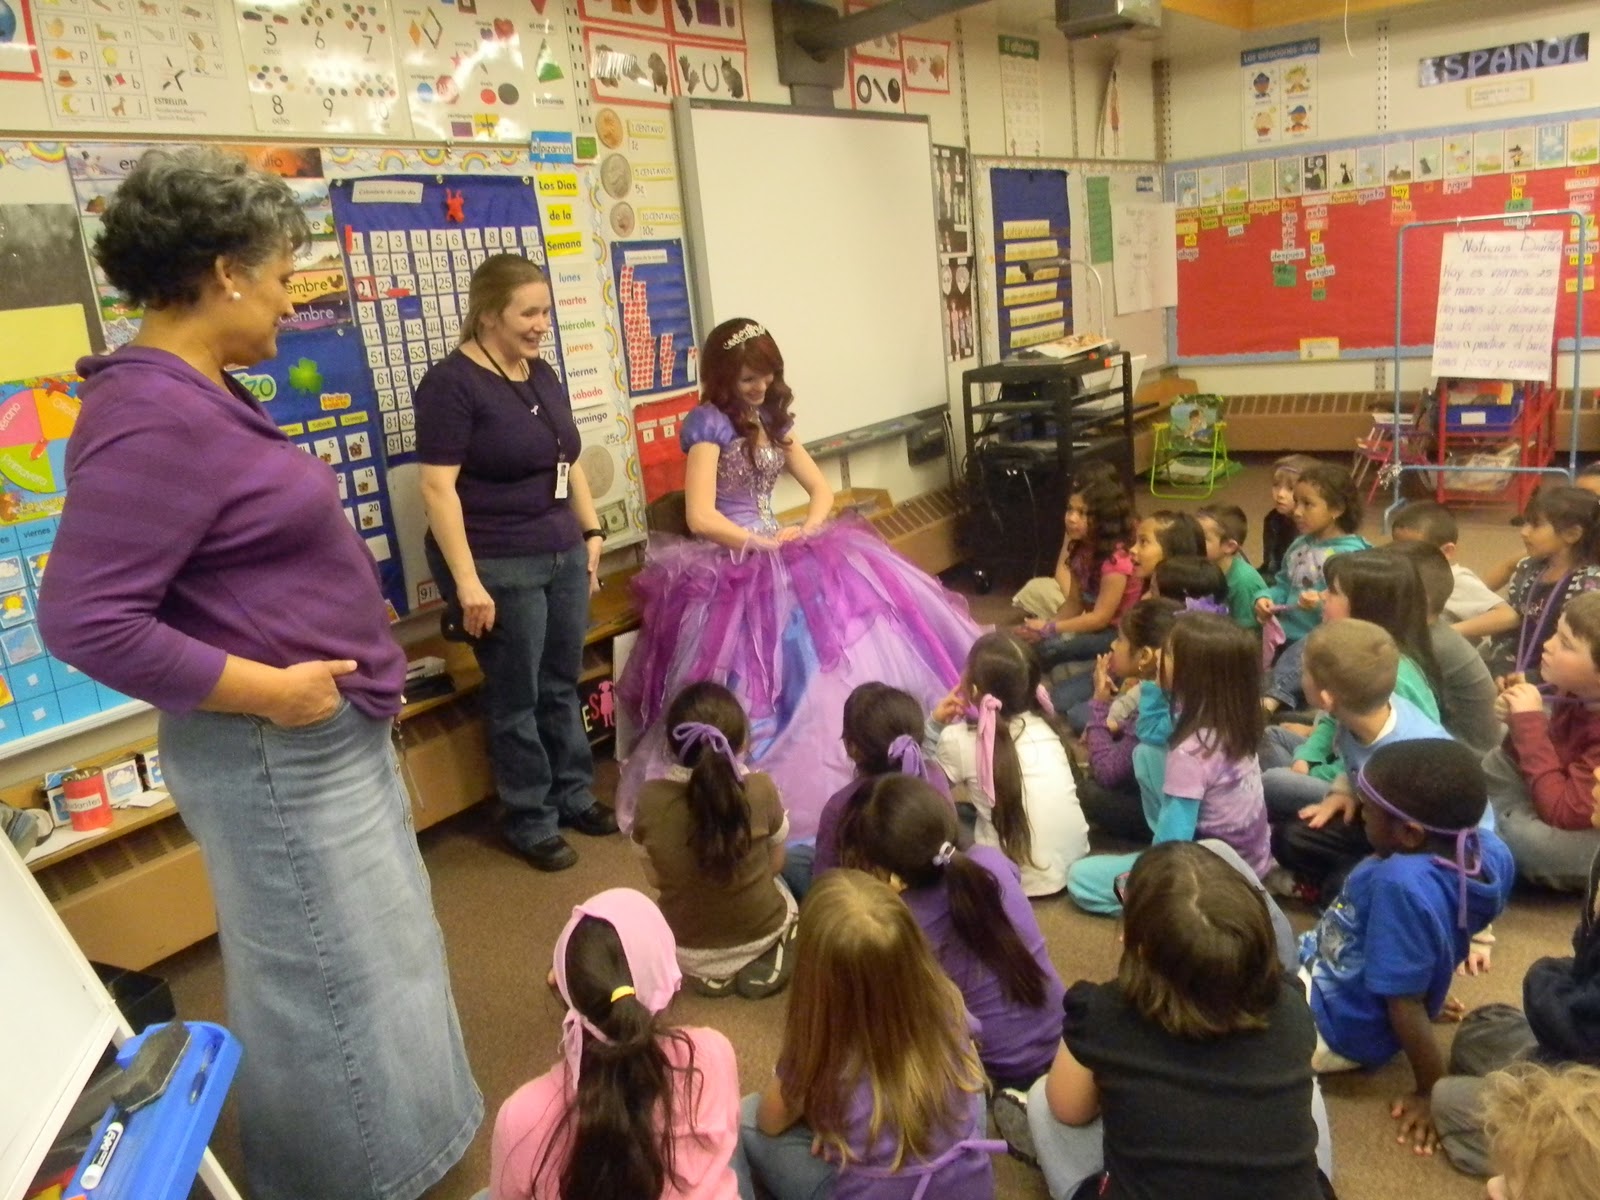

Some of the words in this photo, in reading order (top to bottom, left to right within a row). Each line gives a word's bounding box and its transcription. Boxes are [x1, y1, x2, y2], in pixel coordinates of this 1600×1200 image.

[264, 25, 278, 46] 5
[315, 31, 326, 49] 6
[362, 35, 373, 54] 7
[271, 94, 284, 115] 8
[323, 98, 334, 117] 9
[539, 181, 555, 191] Los
[549, 210, 560, 221] de
[563, 210, 572, 220] la
[353, 237, 359, 250] 1
[376, 235, 384, 249] 2
[395, 235, 403, 248] 3
[415, 234, 423, 246] 4
[435, 233, 443, 246] 5
[451, 234, 459, 246] 6
[469, 232, 476, 245] 7
[488, 231, 496, 244] 8
[505, 231, 512, 243] 9
[525, 231, 537, 242] 10
[547, 240, 582, 252] Semana
[355, 260, 367, 272] 11
[376, 258, 389, 271] 12
[395, 257, 408, 271] 13
[417, 256, 429, 269] 14
[435, 256, 448, 268] 15
[455, 255, 467, 268] 16
[473, 254, 484, 267] 17
[559, 272, 581, 283] lunes
[1470, 269, 1483, 278] es
[286, 278, 328, 295] embre
[359, 281, 374, 297] 21
[421, 278, 433, 291] 24
[439, 277, 452, 290] 25
[458, 275, 470, 288] 26
[361, 306, 374, 319] 31
[383, 304, 397, 317] 32
[423, 300, 436, 314] 34
[558, 297, 587, 307] martes
[364, 328, 380, 341] 41
[386, 325, 401, 339] 42
[406, 323, 423, 336] 43
[426, 320, 440, 334] 44
[444, 319, 460, 332] 45
[370, 350, 384, 364] 51
[390, 348, 403, 361] 52
[410, 346, 426, 360] 53
[431, 343, 444, 356] 54
[566, 343, 594, 355] jueves
[376, 372, 390, 385] 61
[394, 369, 407, 383] 62
[541, 349, 556, 362] 70
[568, 366, 598, 378] viernes
[380, 394, 394, 408] 73
[398, 391, 411, 405] 72
[386, 416, 398, 430] 81
[401, 413, 414, 426] 82
[328, 440, 335, 449] 5
[359, 434, 365, 443] 6
[388, 438, 400, 452] 91
[364, 469, 374, 479] 13
[368, 503, 380, 512] 20
[23, 527, 51, 539] viernes
